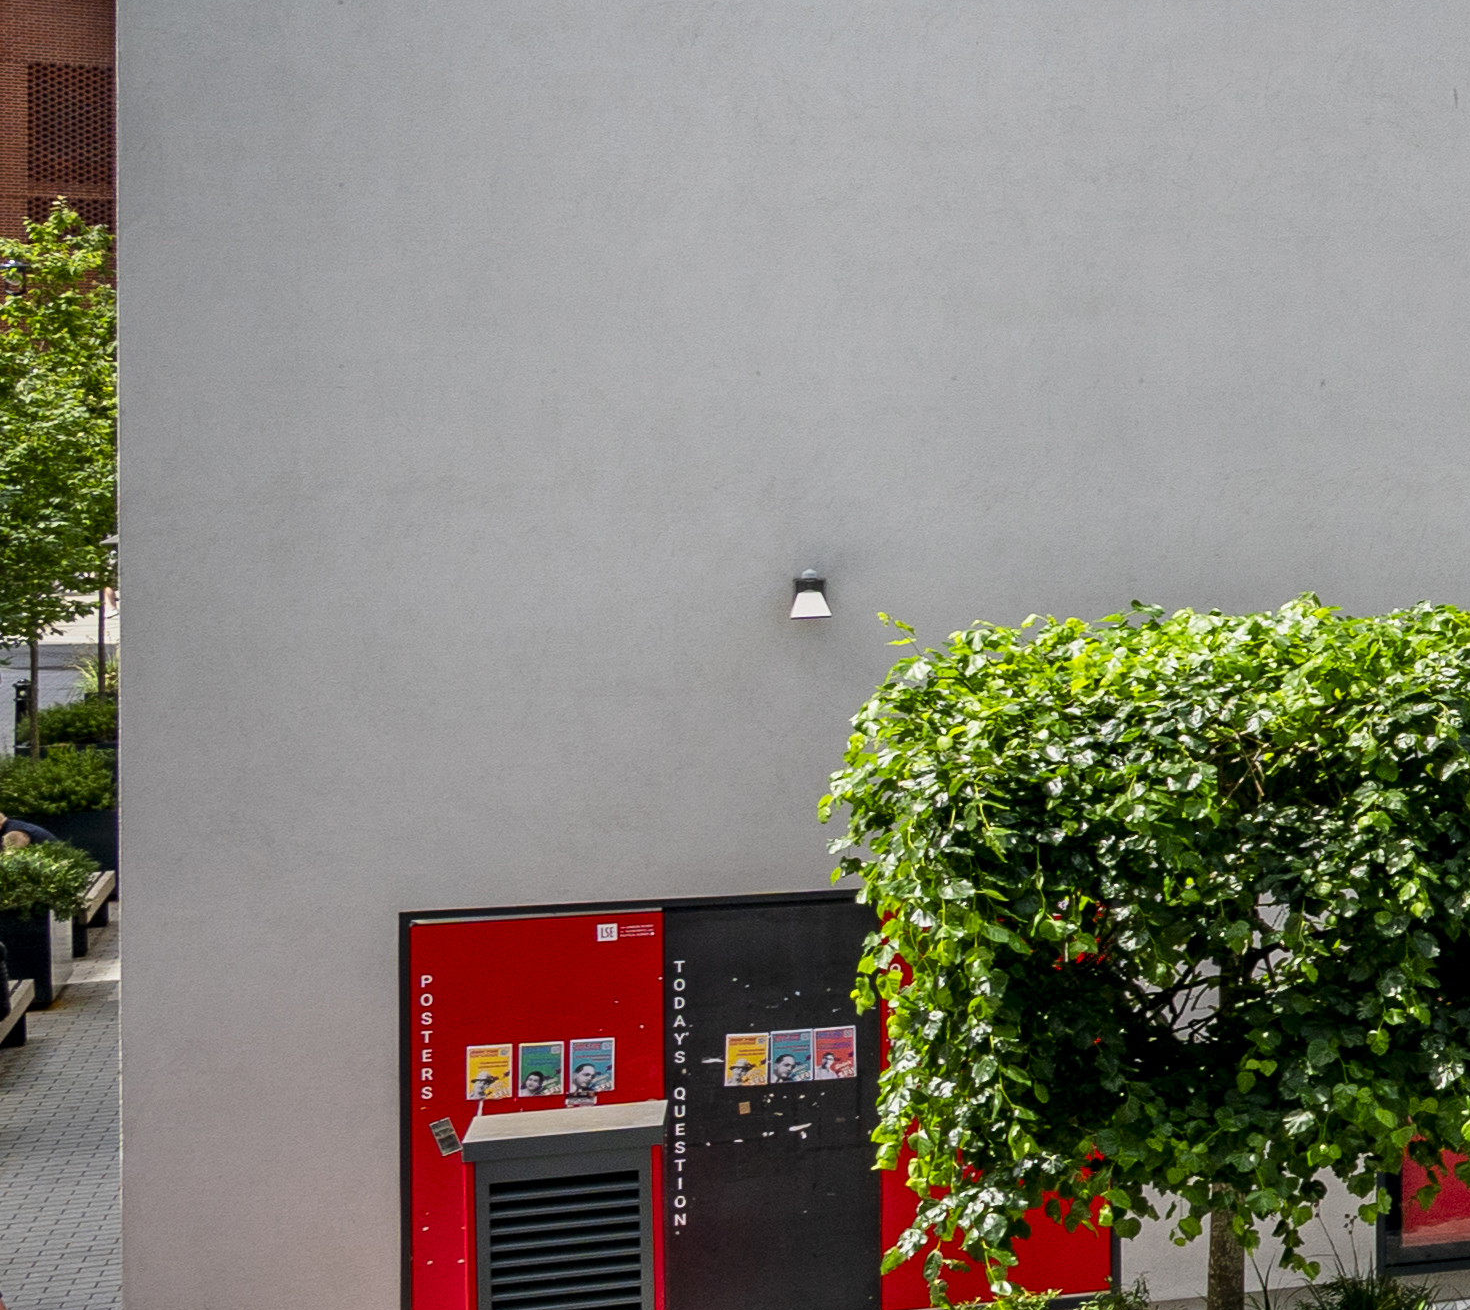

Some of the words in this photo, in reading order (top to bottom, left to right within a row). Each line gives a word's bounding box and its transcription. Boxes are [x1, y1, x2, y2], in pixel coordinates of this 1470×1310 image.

[600, 926, 615, 939] LSE
[420, 975, 433, 1100] POSTERS
[673, 1087, 687, 1227] QUESTION
